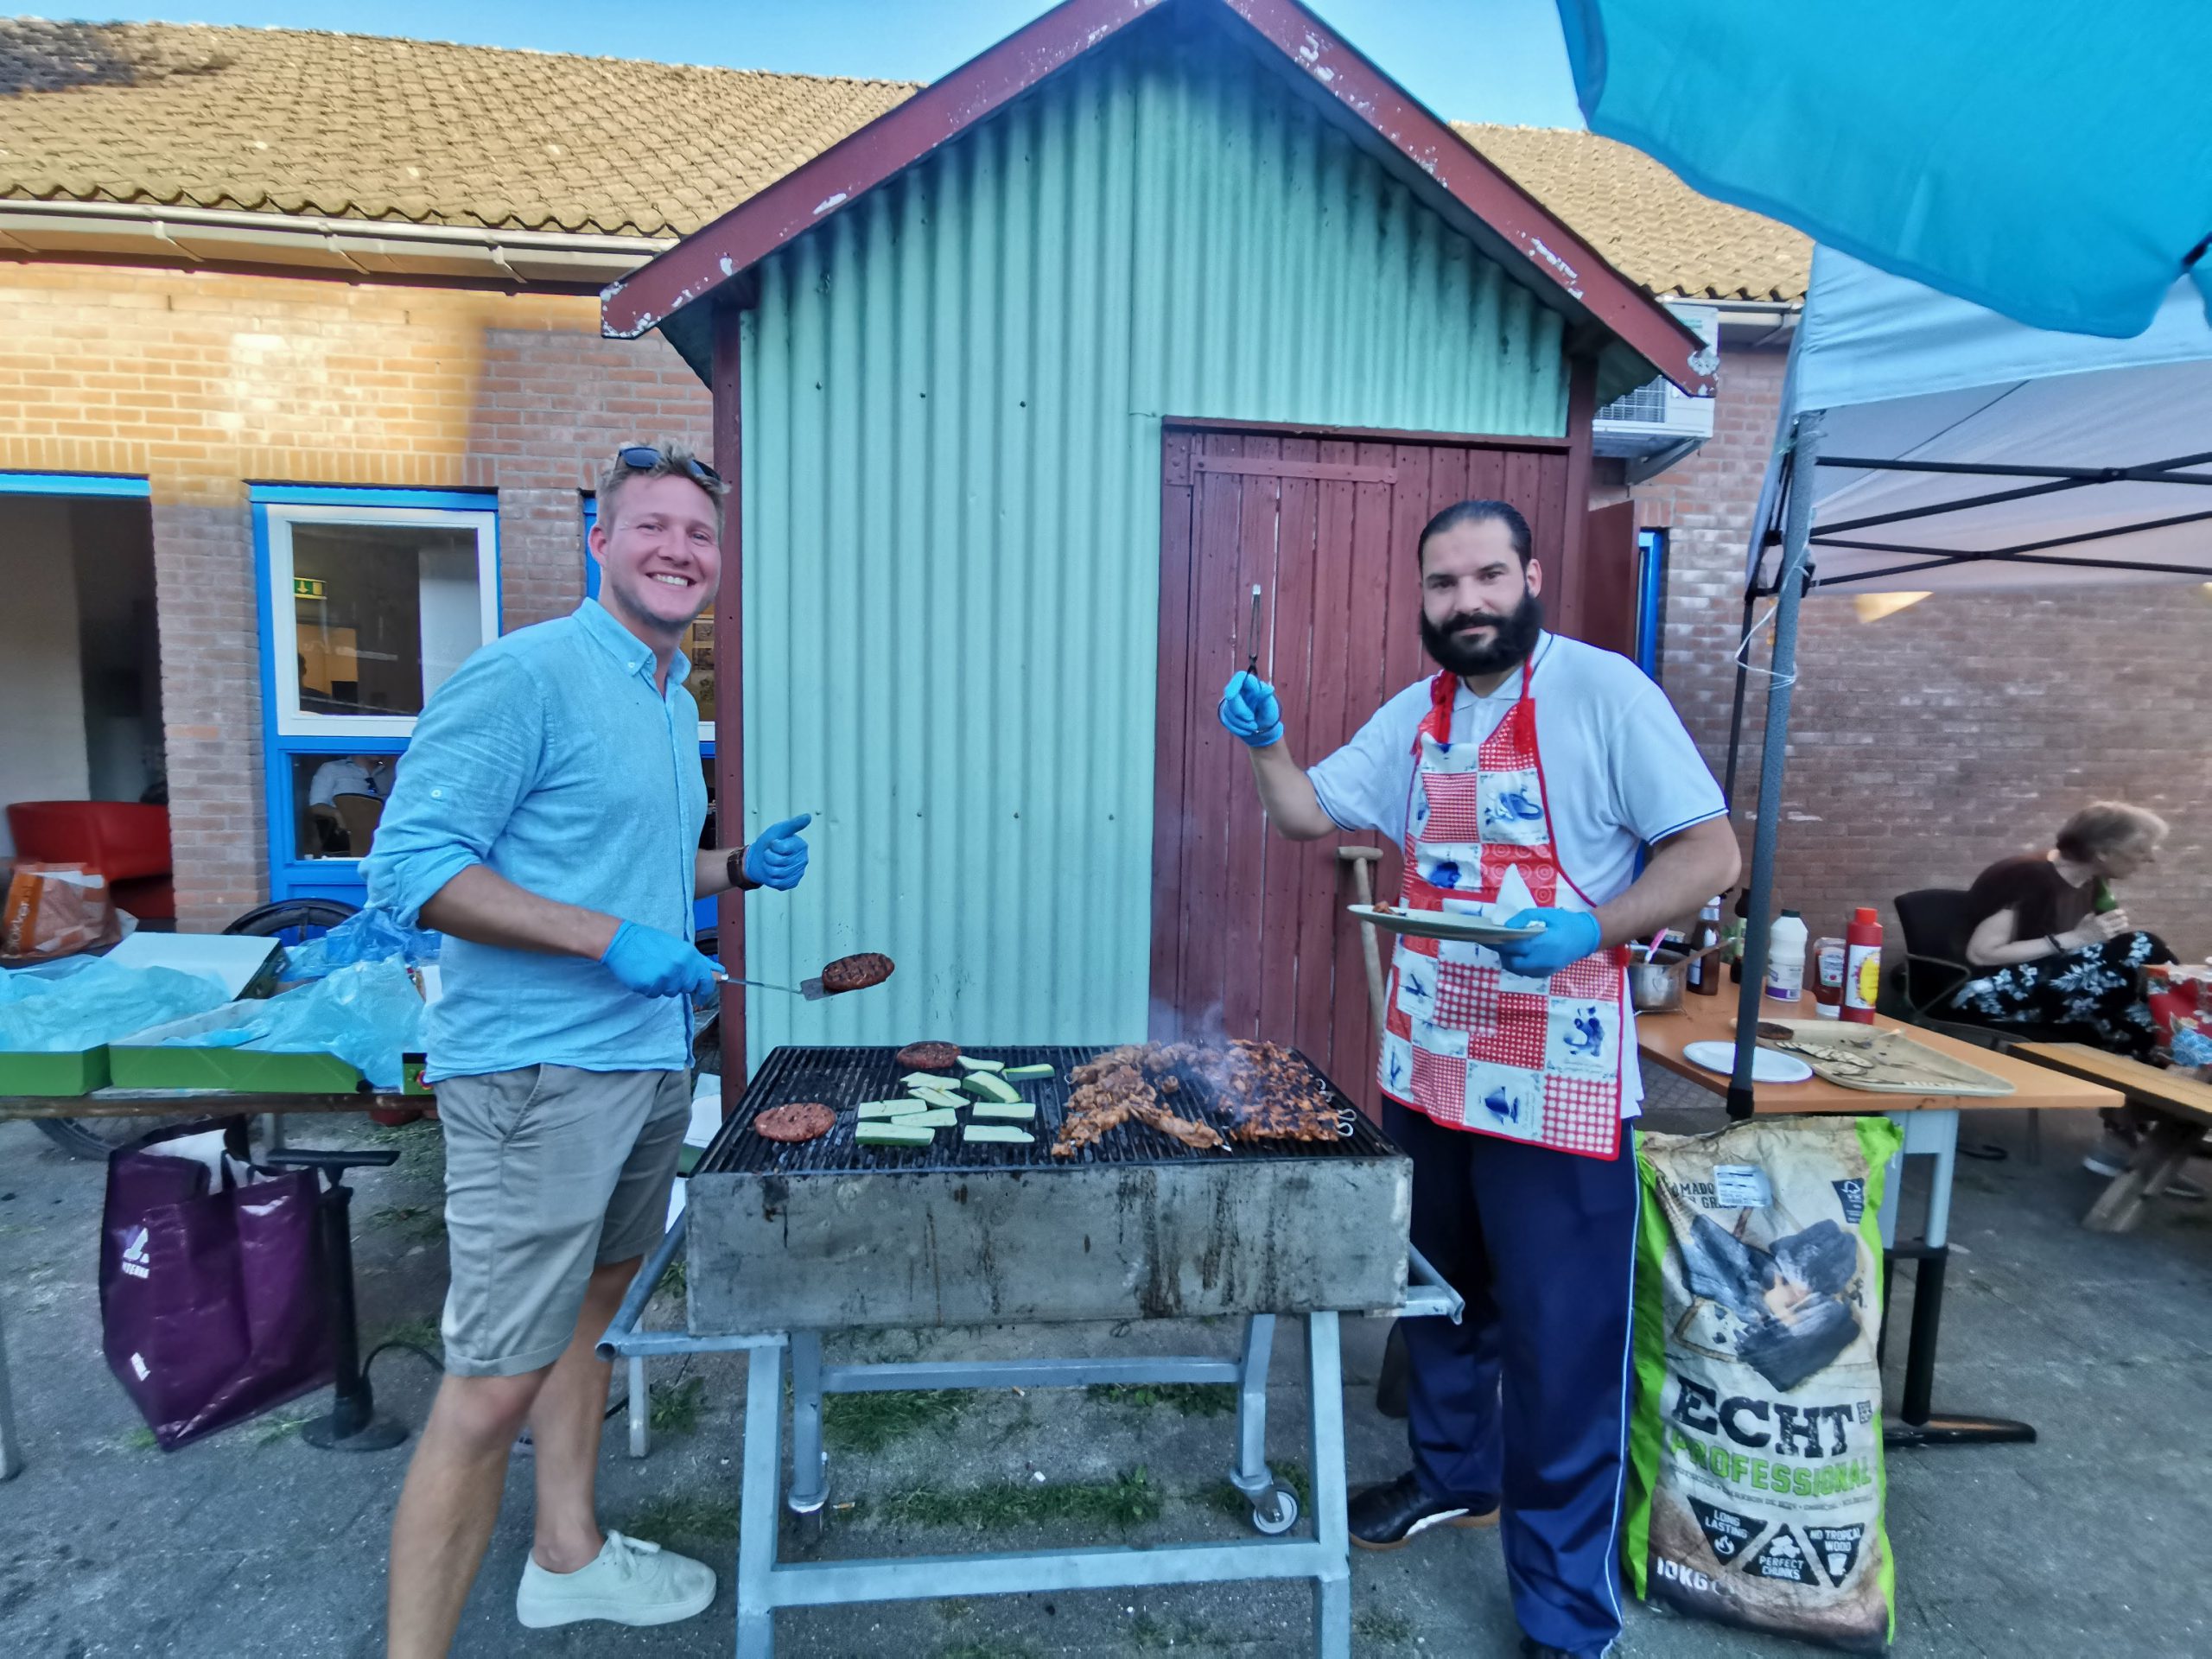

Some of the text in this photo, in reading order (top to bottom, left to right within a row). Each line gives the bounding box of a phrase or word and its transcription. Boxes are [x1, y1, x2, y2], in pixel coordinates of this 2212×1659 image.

[1671, 1374, 1854, 1459] ECHT
[1669, 1426, 1872, 1497] PROFESSIONAL
[1713, 1509, 1741, 1527] LONG
[1704, 1516, 1749, 1539] LASTING
[1810, 1529, 1824, 1540] NO
[1824, 1527, 1861, 1541] TROPICAL
[1824, 1540, 1852, 1552] WOOD
[1758, 1555, 1804, 1570] PERFECT
[1762, 1565, 1802, 1580] CHUNKS
